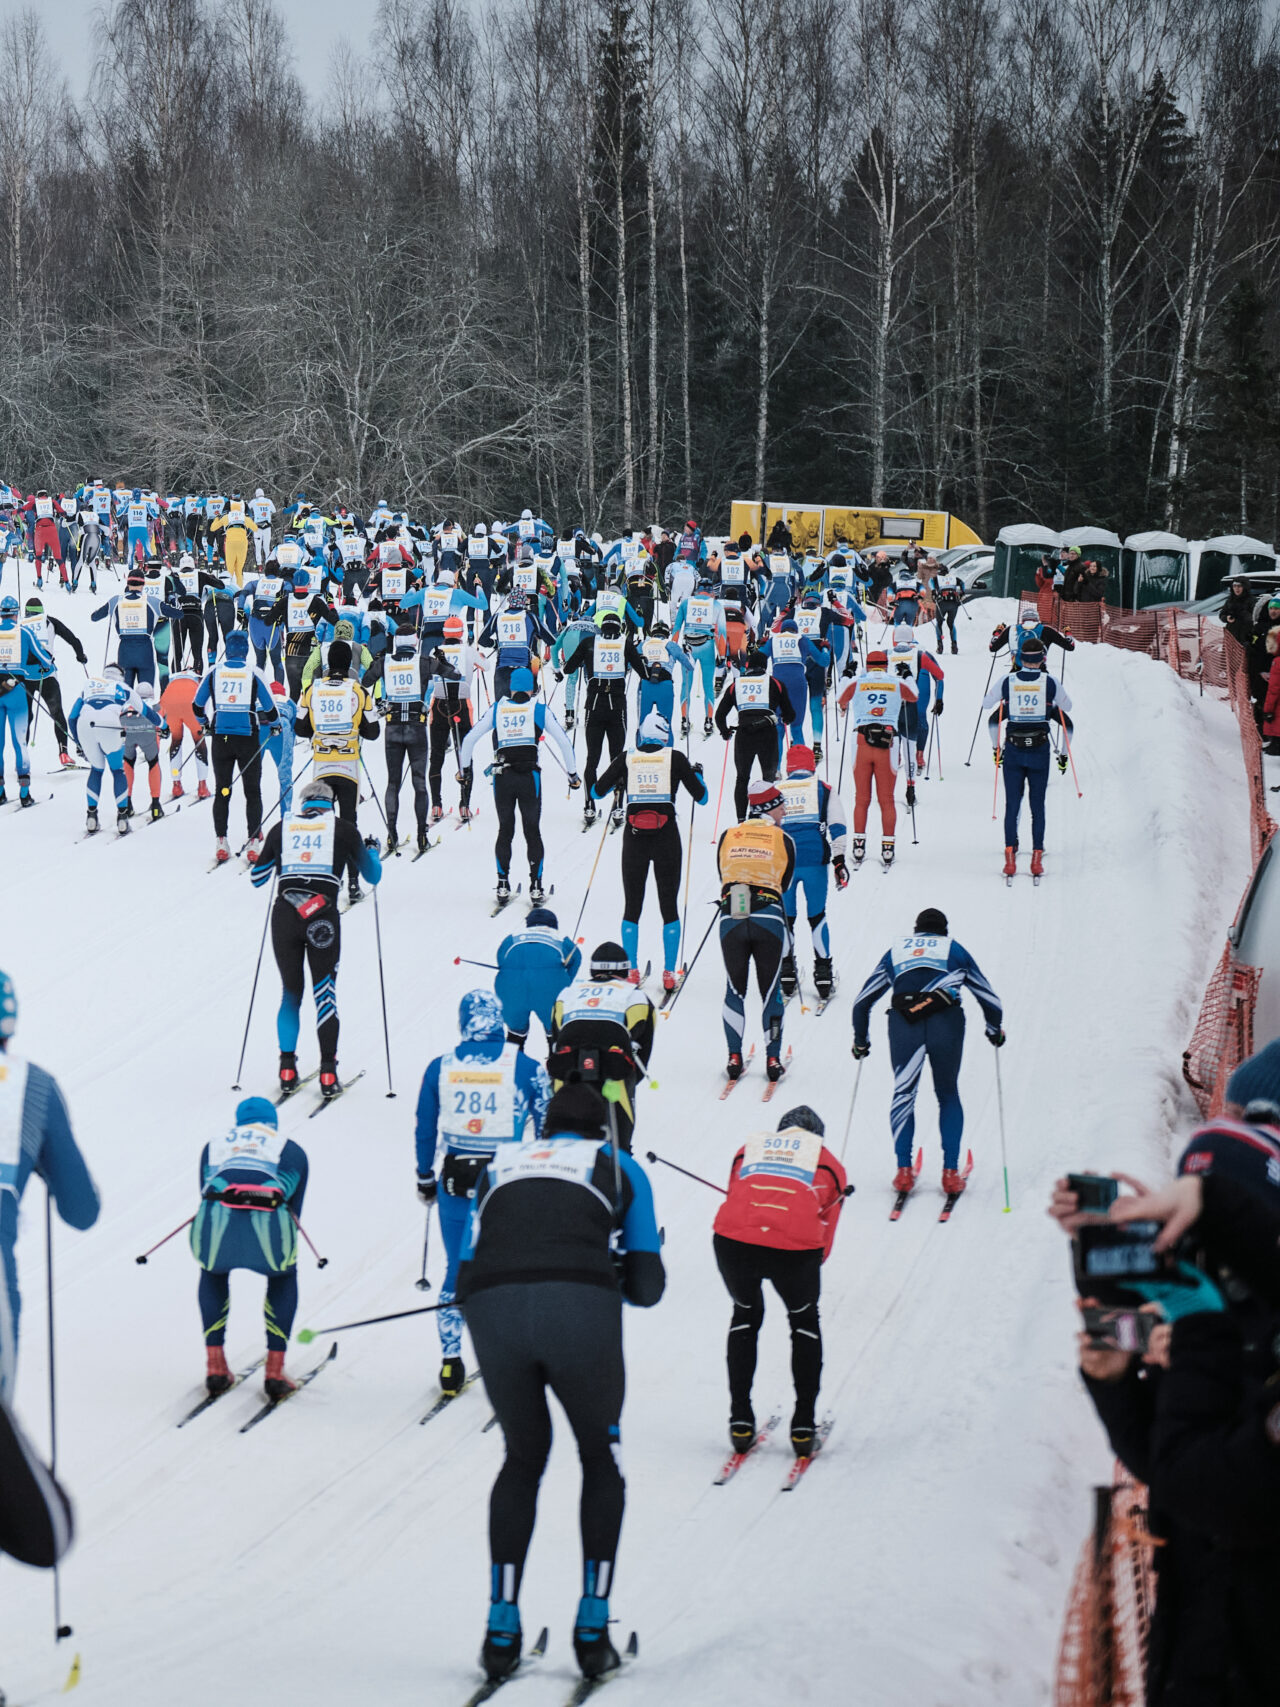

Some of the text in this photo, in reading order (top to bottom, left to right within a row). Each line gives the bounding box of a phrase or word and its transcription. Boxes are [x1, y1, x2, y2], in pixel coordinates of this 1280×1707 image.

[387, 579, 401, 588] 275
[428, 600, 445, 609] 299
[293, 610, 308, 618] 249
[692, 608, 708, 617] 254
[799, 616, 814, 626] 237
[503, 623, 520, 633] 218
[779, 638, 796, 648] 168
[600, 651, 620, 663] 238
[392, 673, 413, 685] 180
[222, 682, 243, 693] 271
[742, 684, 762, 694] 293
[867, 694, 887, 704] 95
[1017, 694, 1038, 706] 196
[320, 699, 343, 712] 386
[503, 715, 526, 728] 349
[637, 774, 659, 784] 5115
[292, 835, 322, 849] 244
[903, 937, 938, 949] 288
[579, 987, 614, 998] 201
[454, 1091, 497, 1114] 284
[763, 1138, 801, 1150] 5018
